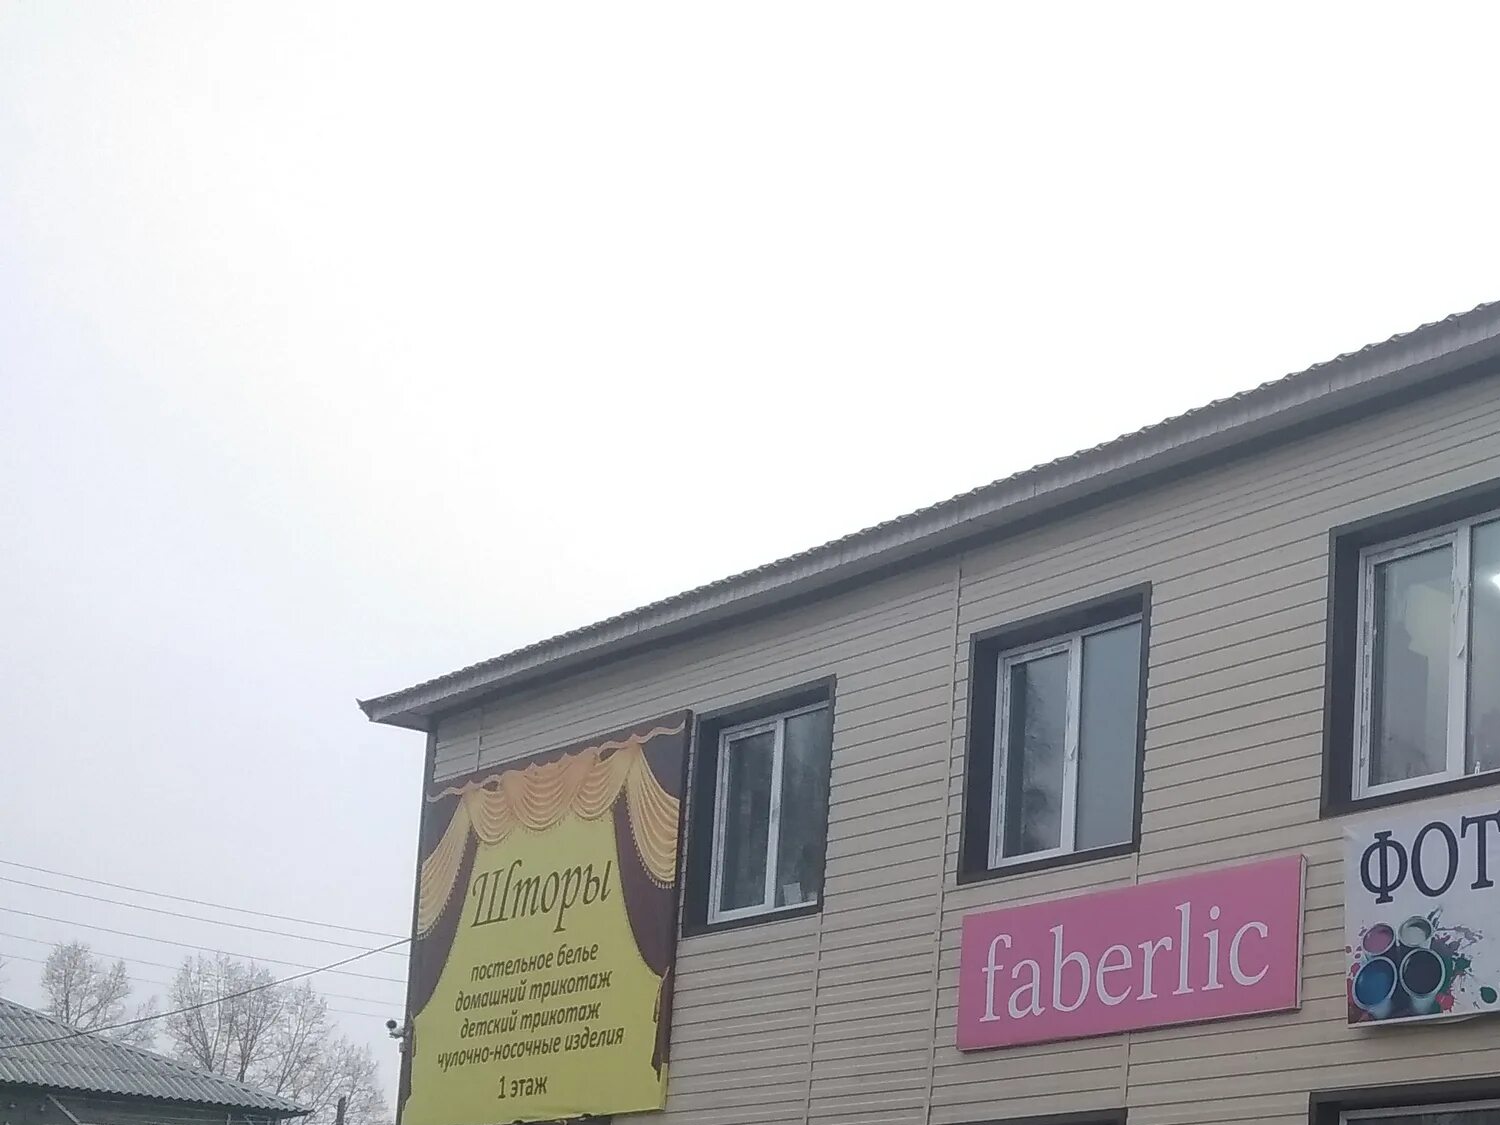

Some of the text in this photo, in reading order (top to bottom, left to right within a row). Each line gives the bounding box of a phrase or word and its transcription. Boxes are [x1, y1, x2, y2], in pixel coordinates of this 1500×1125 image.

[470, 859, 613, 933] Шторы
[470, 943, 599, 982] постельное белье
[979, 901, 1270, 1022] faberlic
[455, 969, 613, 1012] домашний трикотаж
[460, 1001, 601, 1039] детский трикотаж
[437, 1026, 625, 1073] чулочно-носочные изделия
[498, 1076, 548, 1099] 1 этаж
